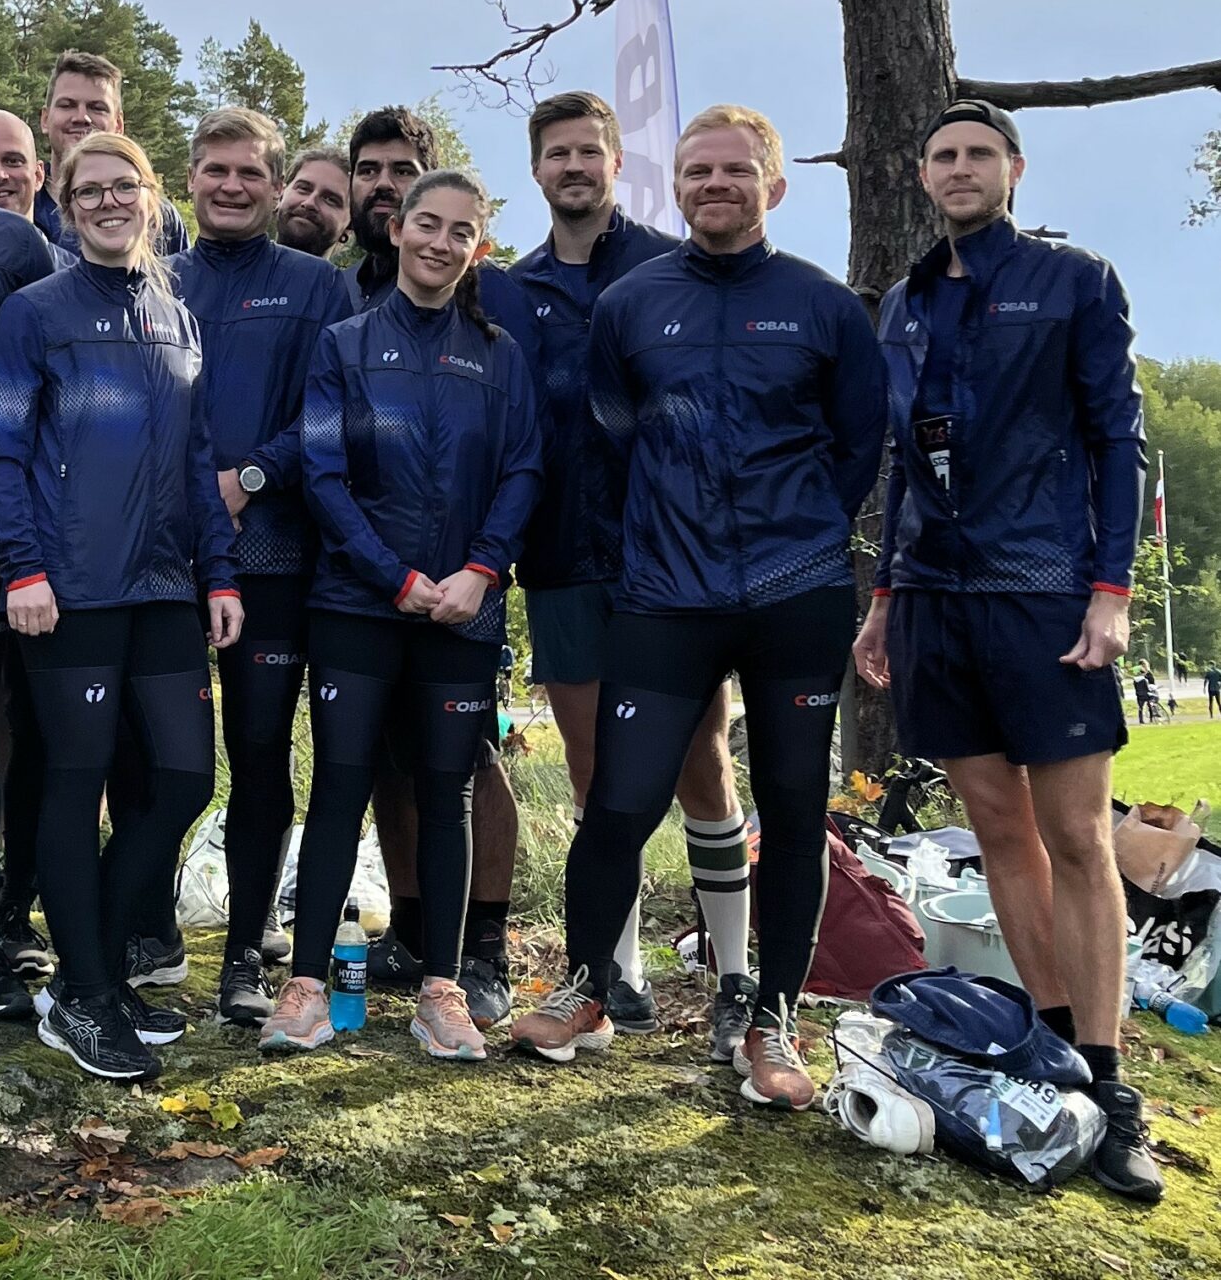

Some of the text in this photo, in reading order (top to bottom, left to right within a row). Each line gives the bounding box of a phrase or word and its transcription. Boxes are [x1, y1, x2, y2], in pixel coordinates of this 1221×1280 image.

[243, 296, 288, 309] COBAB
[989, 302, 1039, 314] COBAB
[746, 321, 799, 332] COBAB
[439, 355, 484, 373] COBAB
[682, 949, 700, 963] 549
